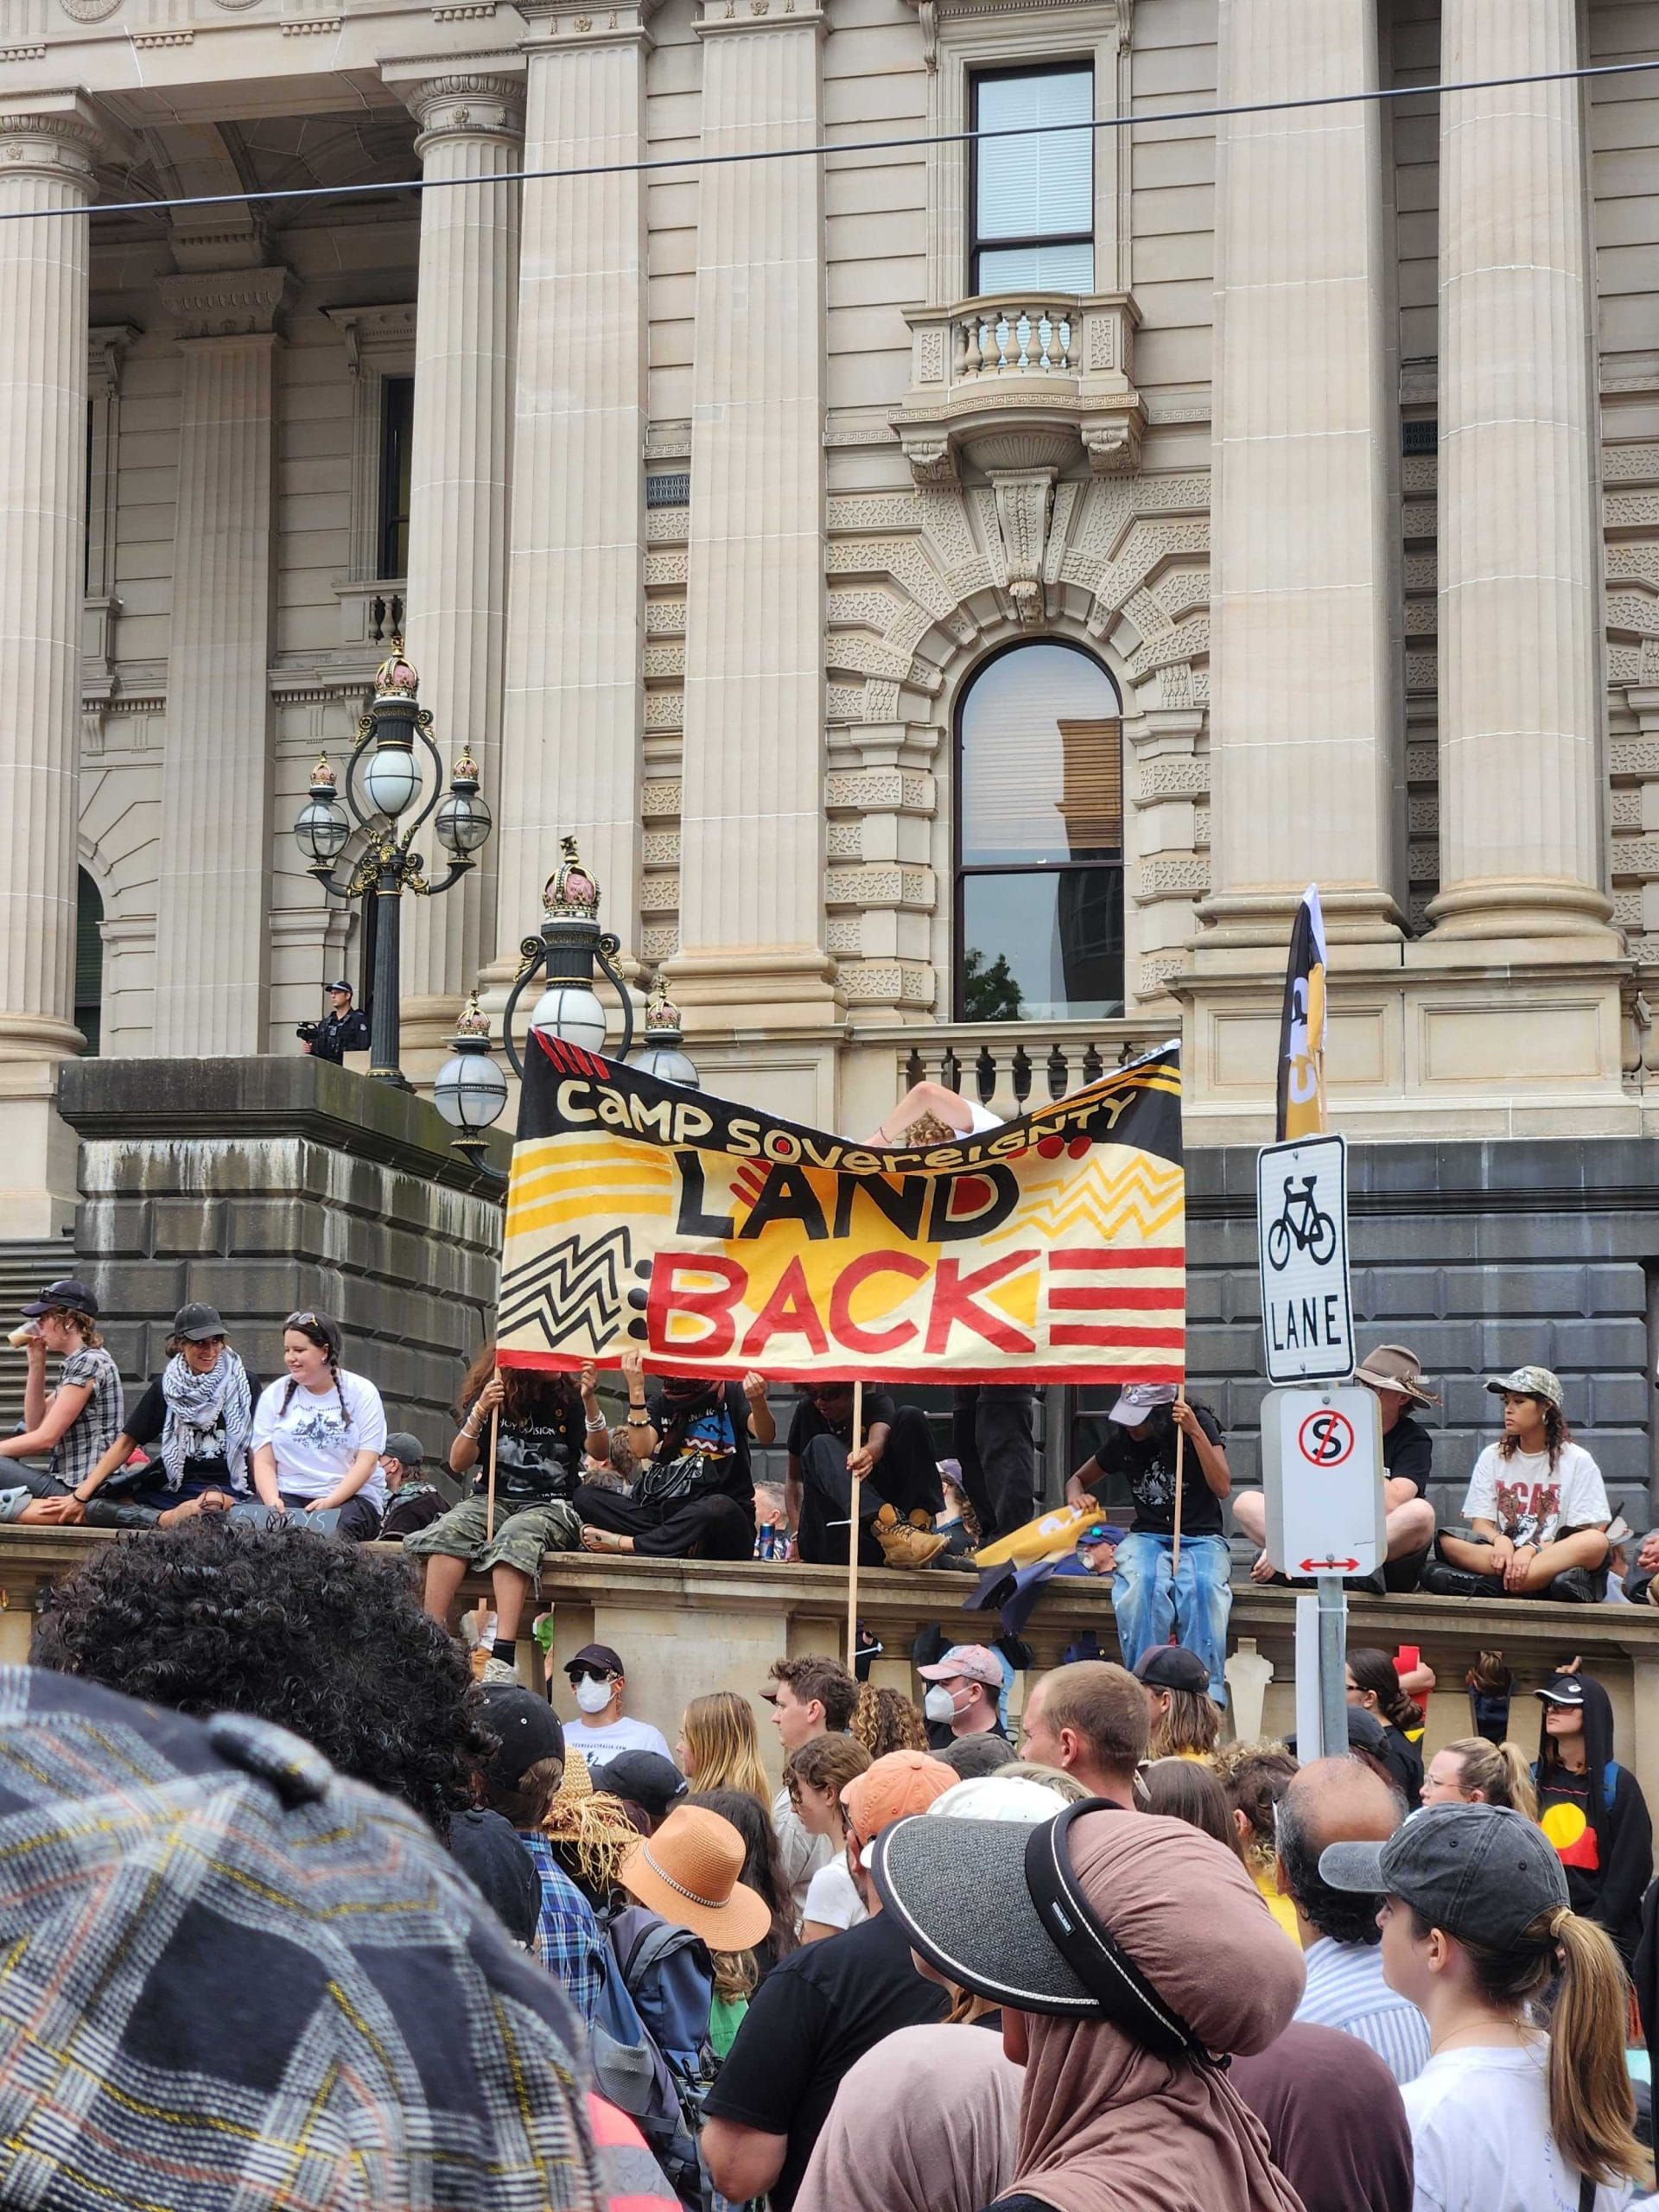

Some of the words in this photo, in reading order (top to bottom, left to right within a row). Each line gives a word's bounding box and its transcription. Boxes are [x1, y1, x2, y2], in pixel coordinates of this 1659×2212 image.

[677, 1151, 1020, 1243] LAND
[646, 1249, 1042, 1357] BACK
[1271, 1294, 1342, 1351] LANE
